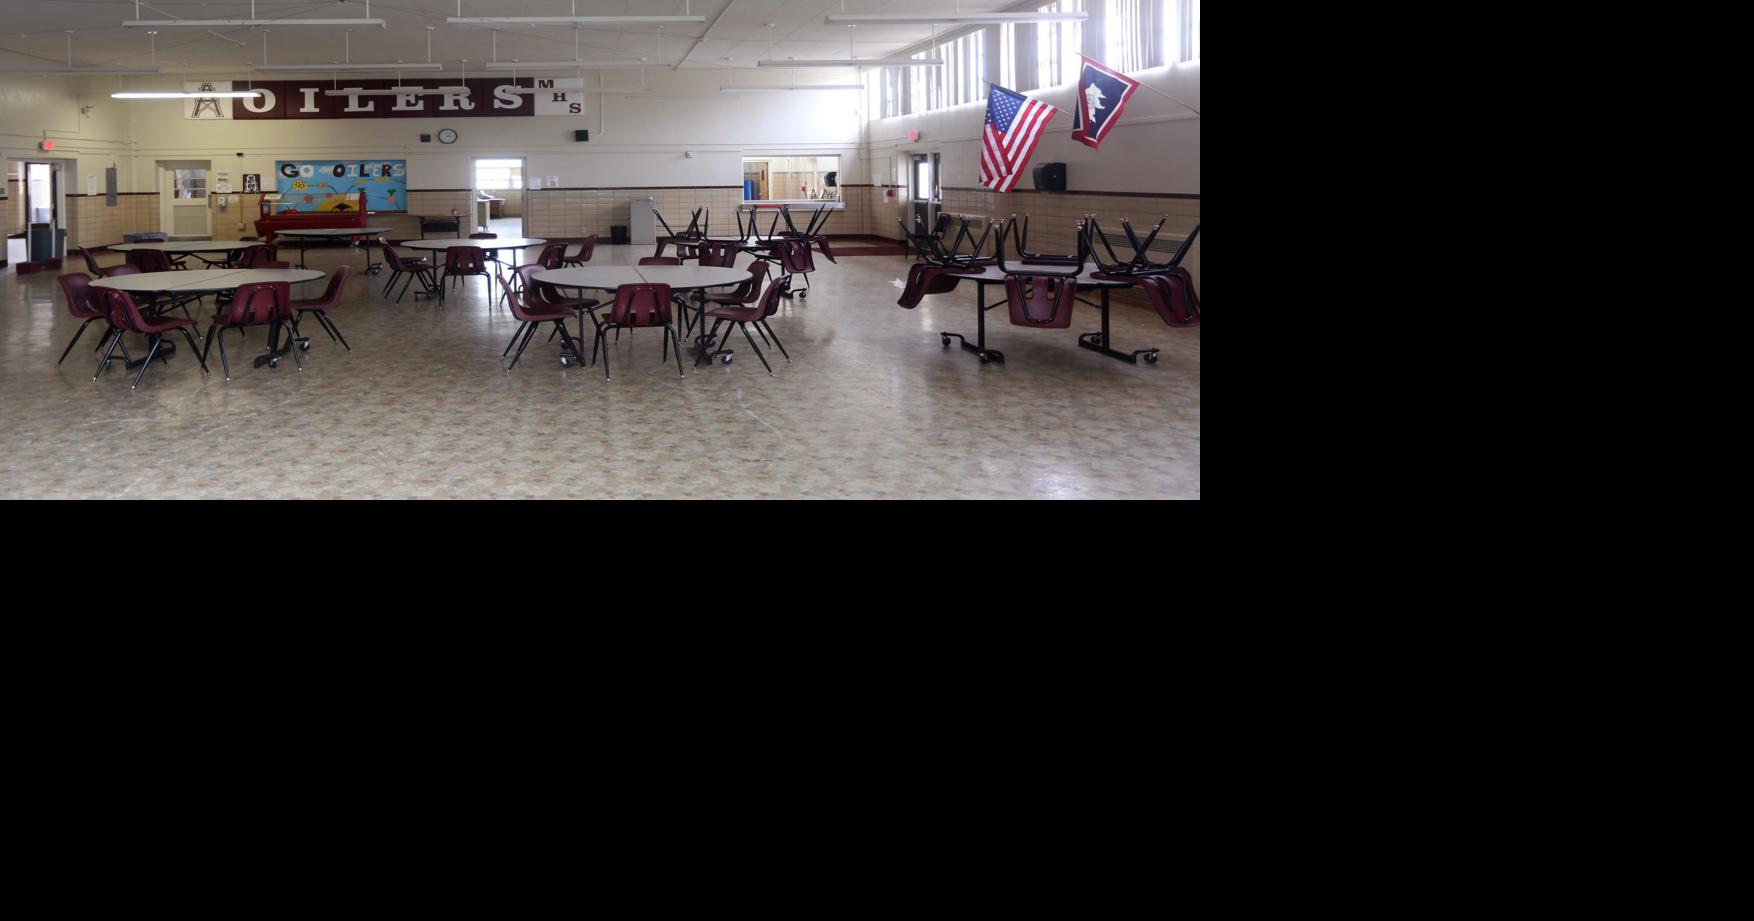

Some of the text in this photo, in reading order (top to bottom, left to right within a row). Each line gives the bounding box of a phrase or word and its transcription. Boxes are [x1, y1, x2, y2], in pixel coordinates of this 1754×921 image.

[242, 84, 524, 113] OILERS
[280, 163, 405, 178] GO OILERS
